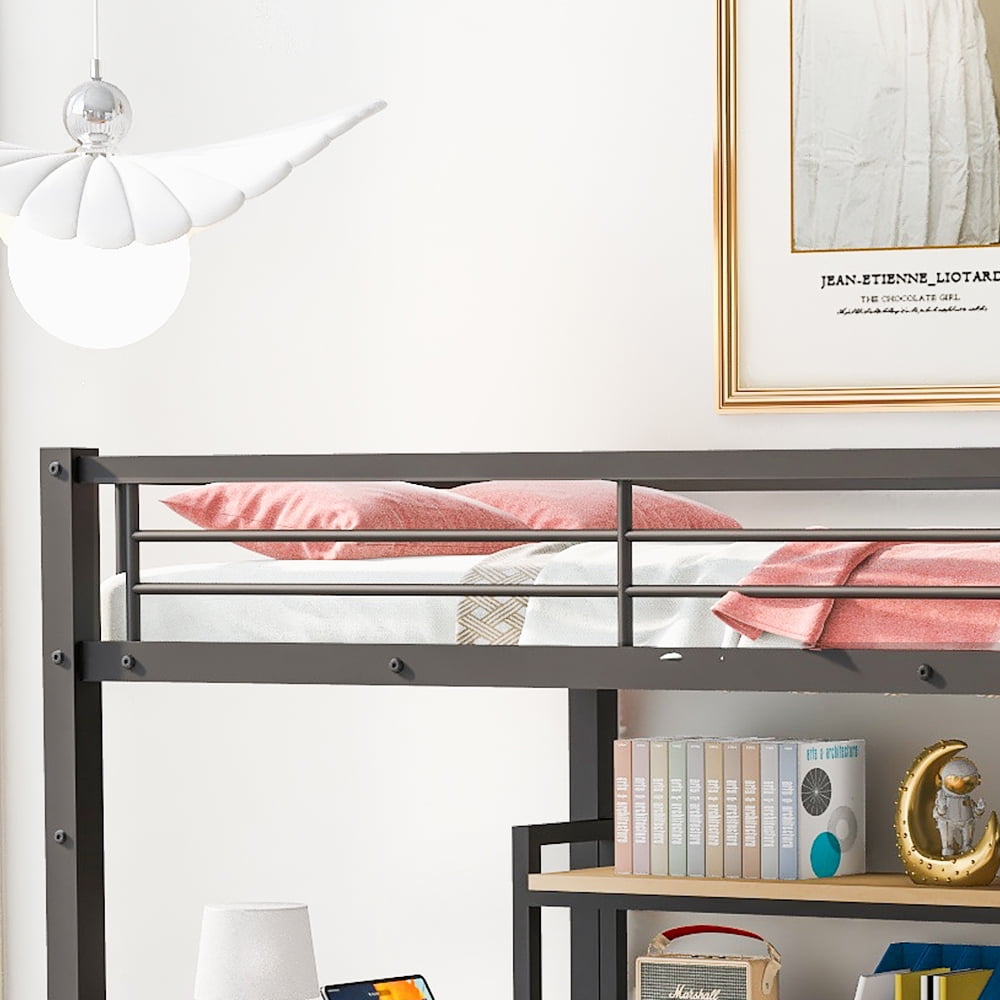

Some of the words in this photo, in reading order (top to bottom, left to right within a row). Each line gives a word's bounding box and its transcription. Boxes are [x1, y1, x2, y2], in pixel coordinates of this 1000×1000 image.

[861, 295, 878, 303] THE
[881, 294, 936, 303] CHOCOLATE
[668, 984, 721, 1000] Marshall
